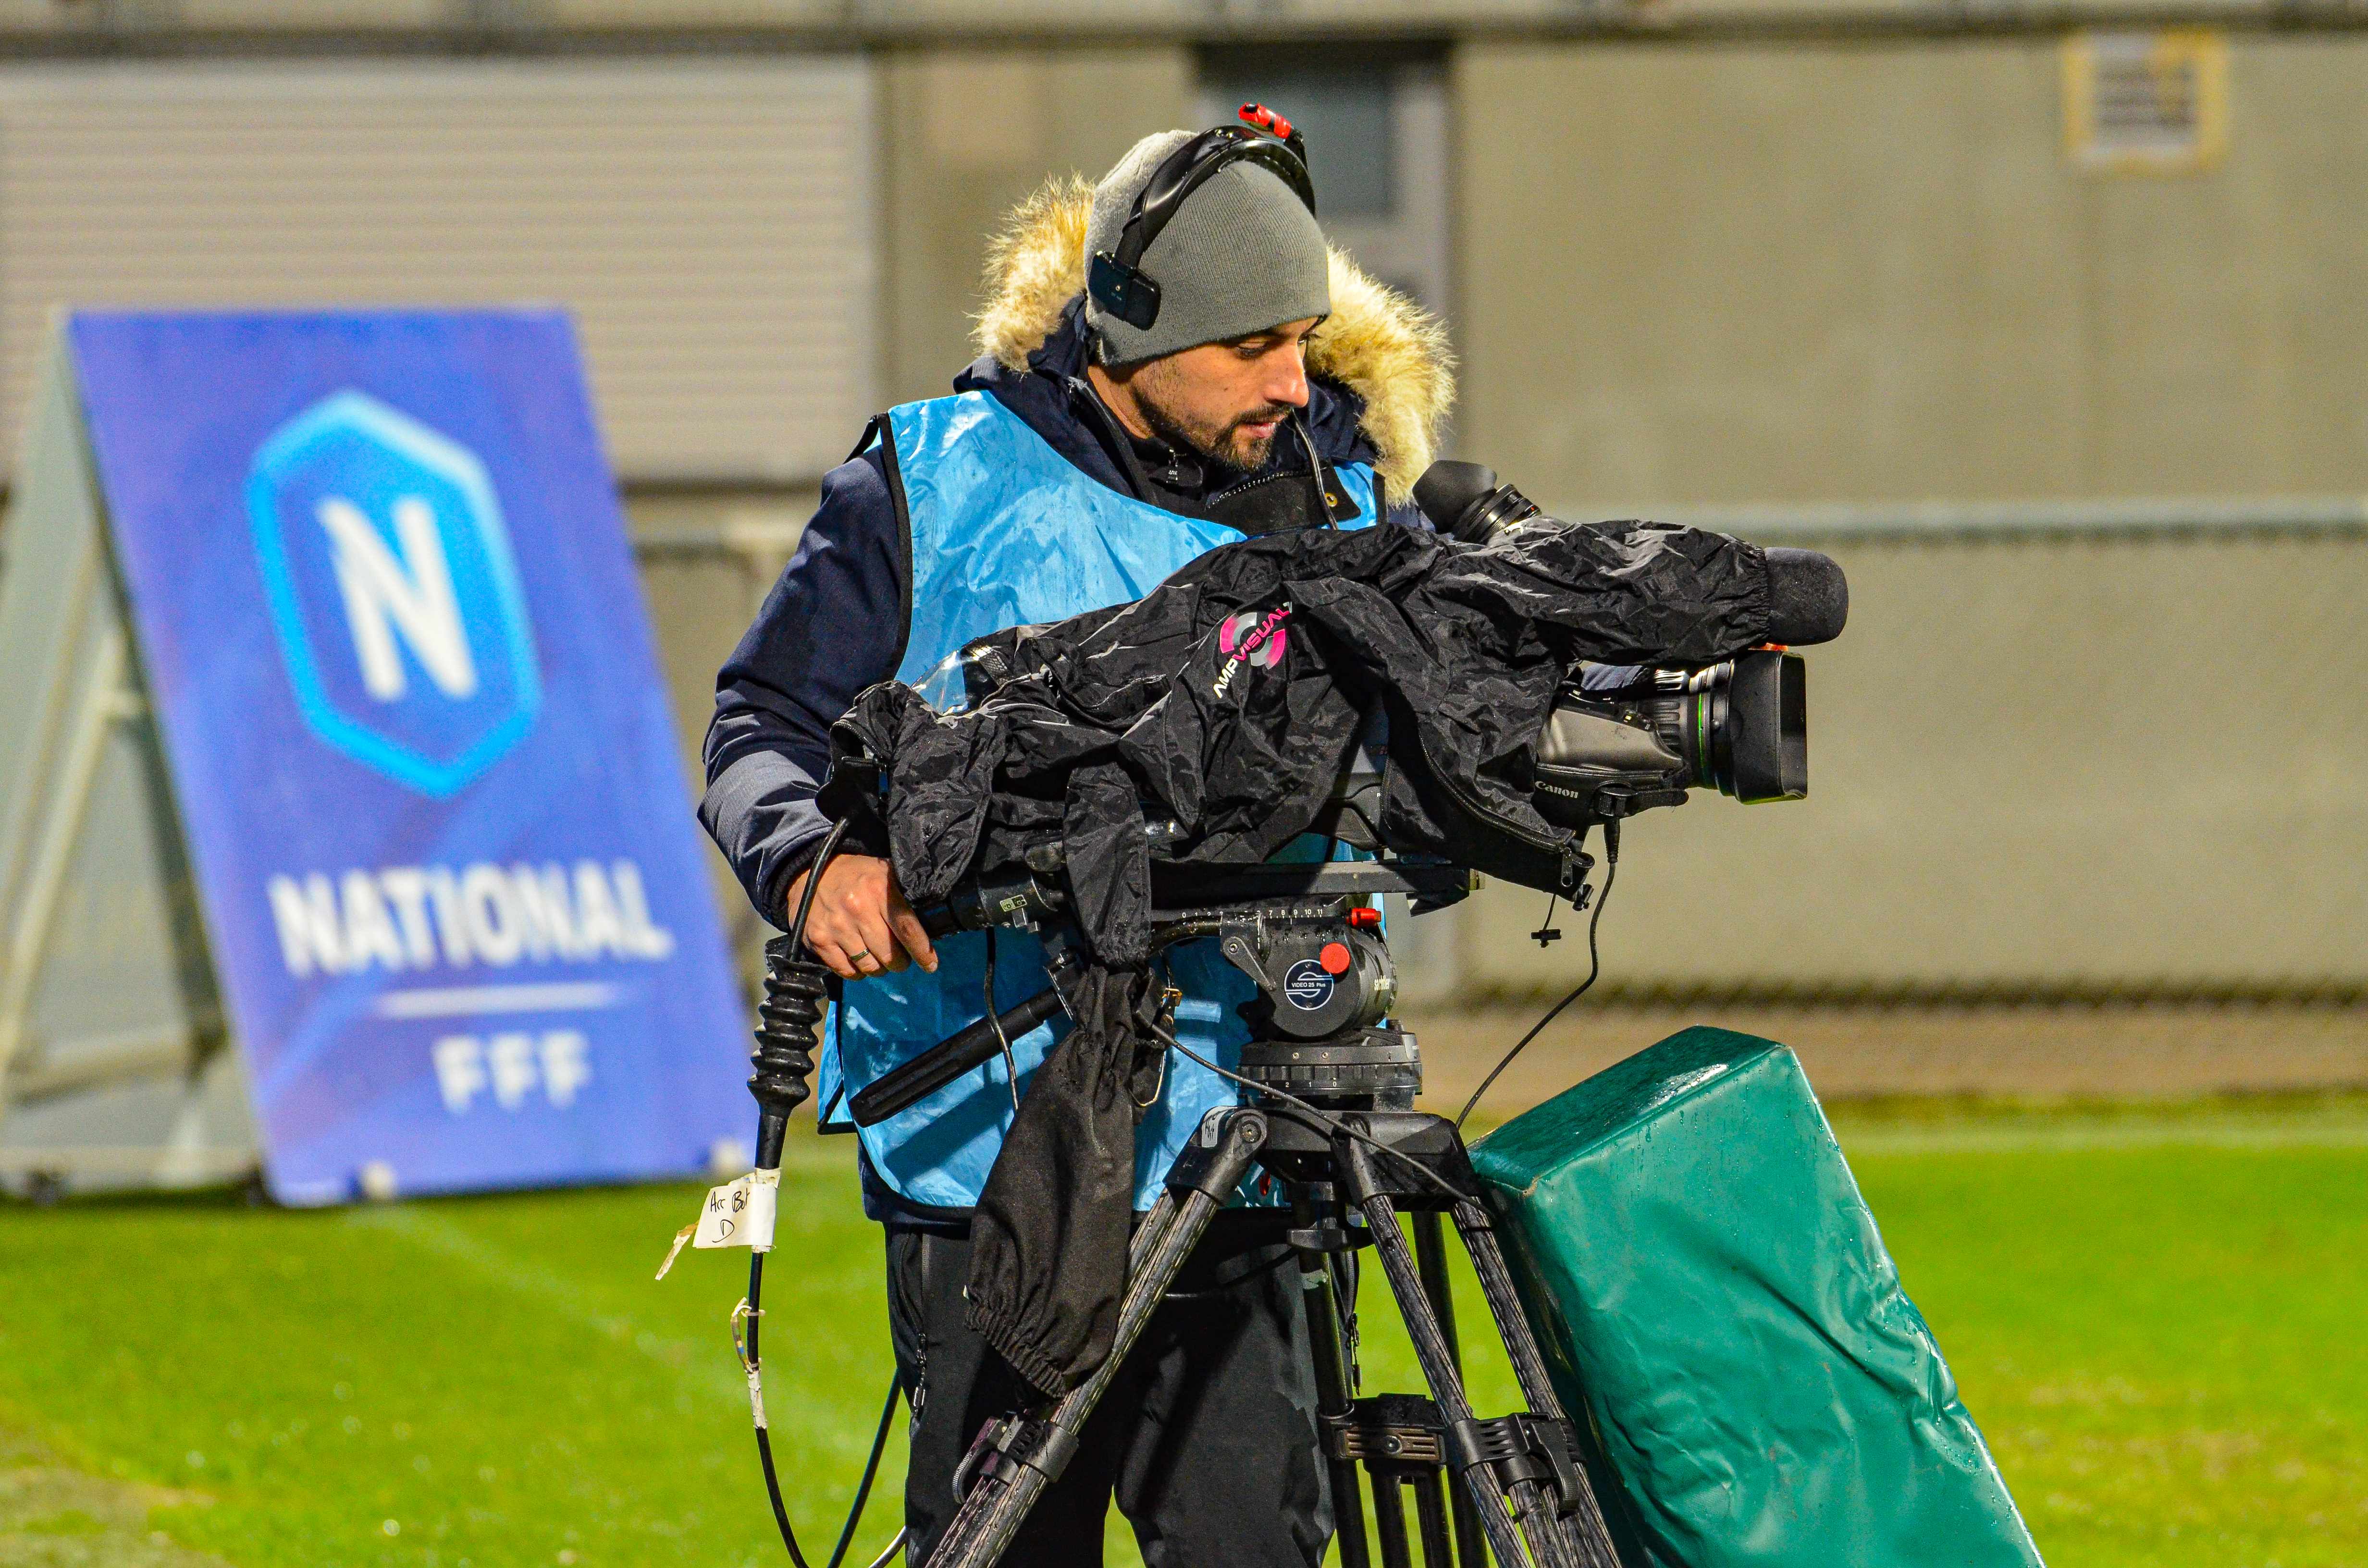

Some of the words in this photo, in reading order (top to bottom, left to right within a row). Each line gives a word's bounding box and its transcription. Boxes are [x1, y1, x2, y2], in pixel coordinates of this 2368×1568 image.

[318, 496, 476, 701] N
[1535, 781, 1579, 798] Canon
[269, 860, 674, 977] NATIONAL
[433, 1031, 591, 1112] FFF
[712, 1219, 735, 1243] D
